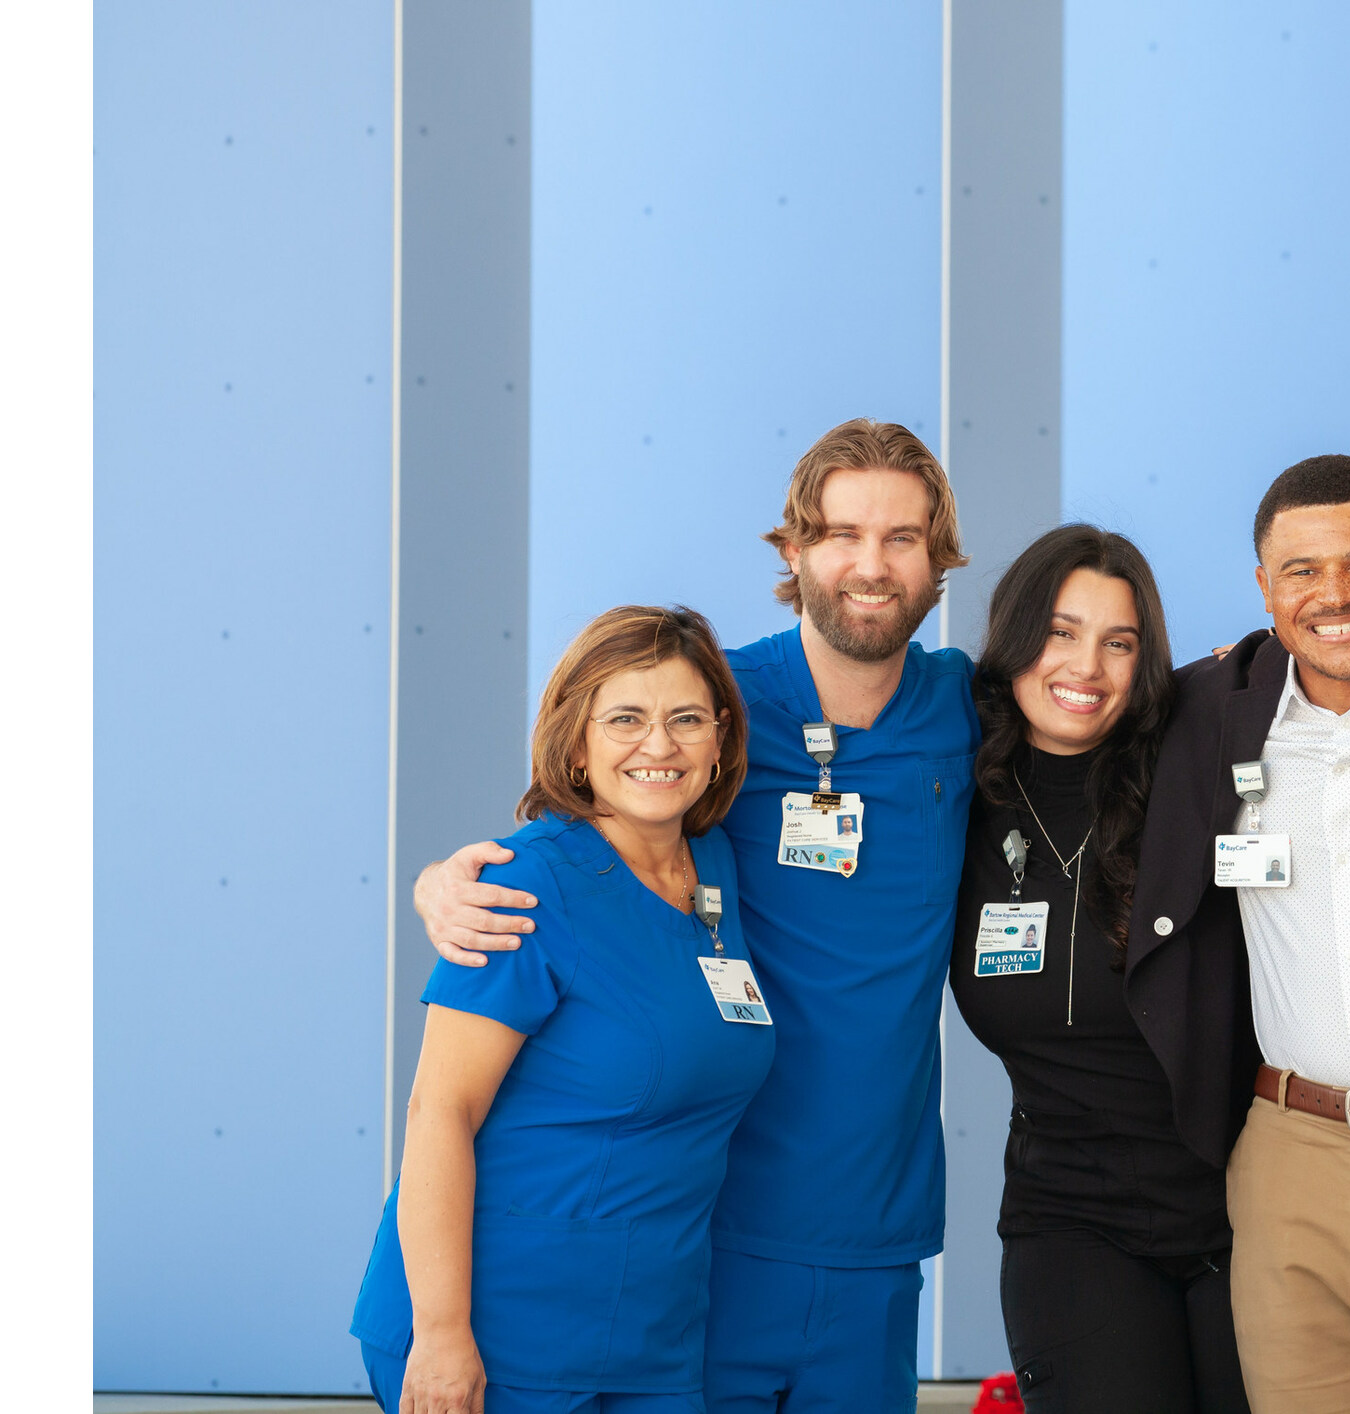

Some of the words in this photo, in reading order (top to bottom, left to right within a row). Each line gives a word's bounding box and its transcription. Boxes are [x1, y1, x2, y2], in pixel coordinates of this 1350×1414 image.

[785, 847, 813, 864] RN
[982, 952, 1039, 965] PHARMACY
[995, 963, 1023, 973] TECH
[732, 1005, 756, 1020] RN
